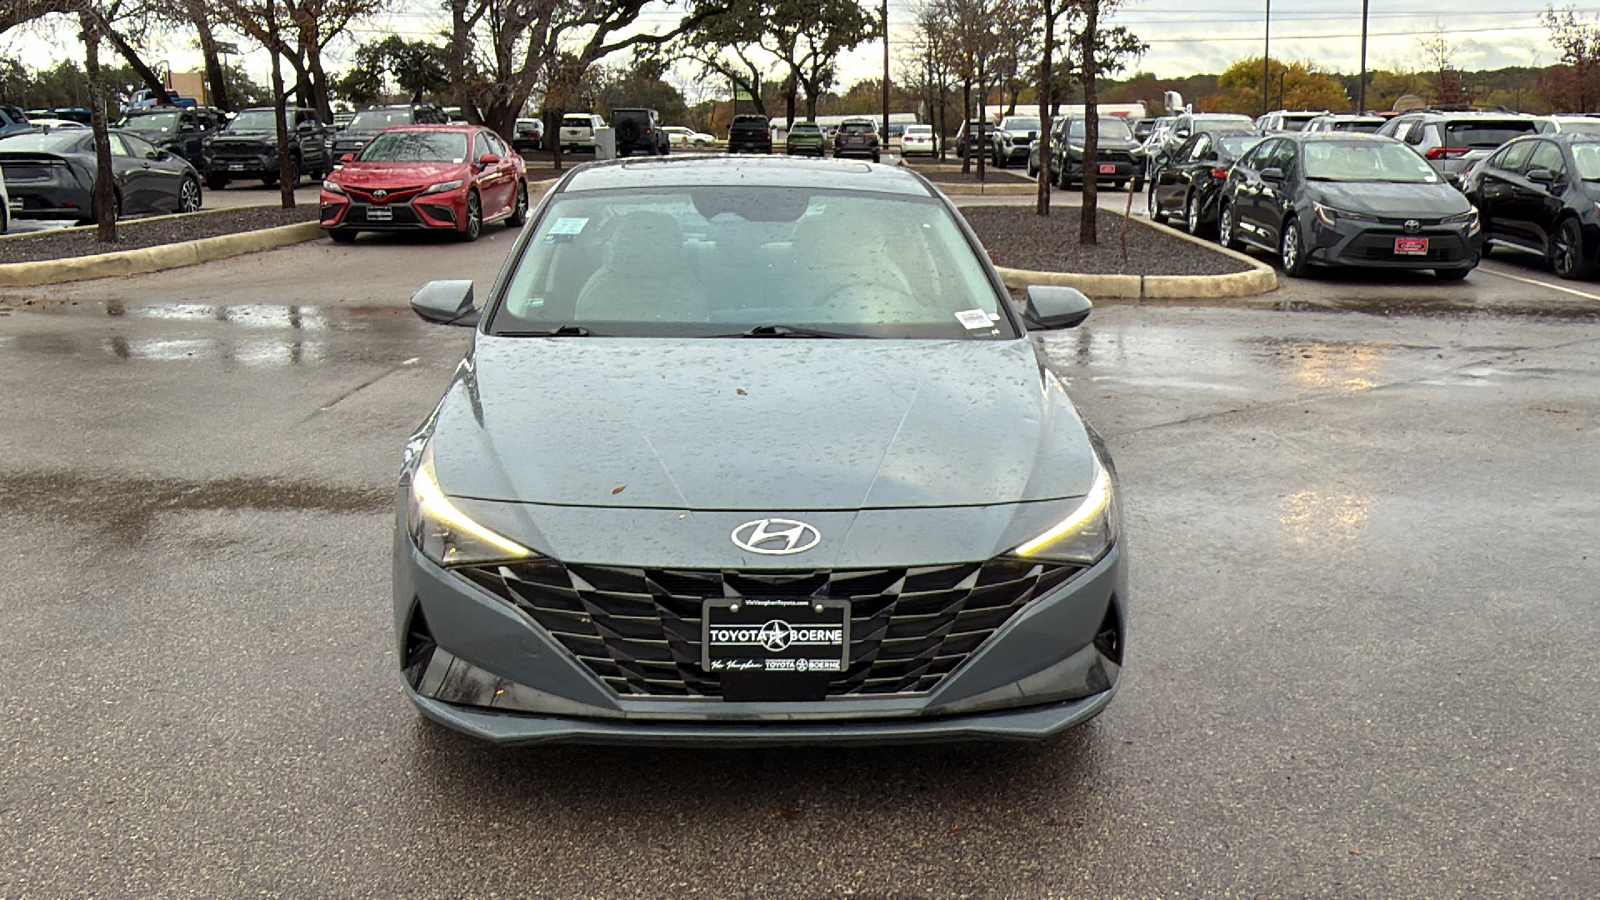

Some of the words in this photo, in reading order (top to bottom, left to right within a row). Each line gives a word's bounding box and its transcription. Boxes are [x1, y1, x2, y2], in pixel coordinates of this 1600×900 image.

[710, 630, 767, 641] TOYOTA
[790, 630, 842, 641] BOERNE
[765, 660, 795, 669] TOYOTA
[809, 660, 840, 669] BOERNE
